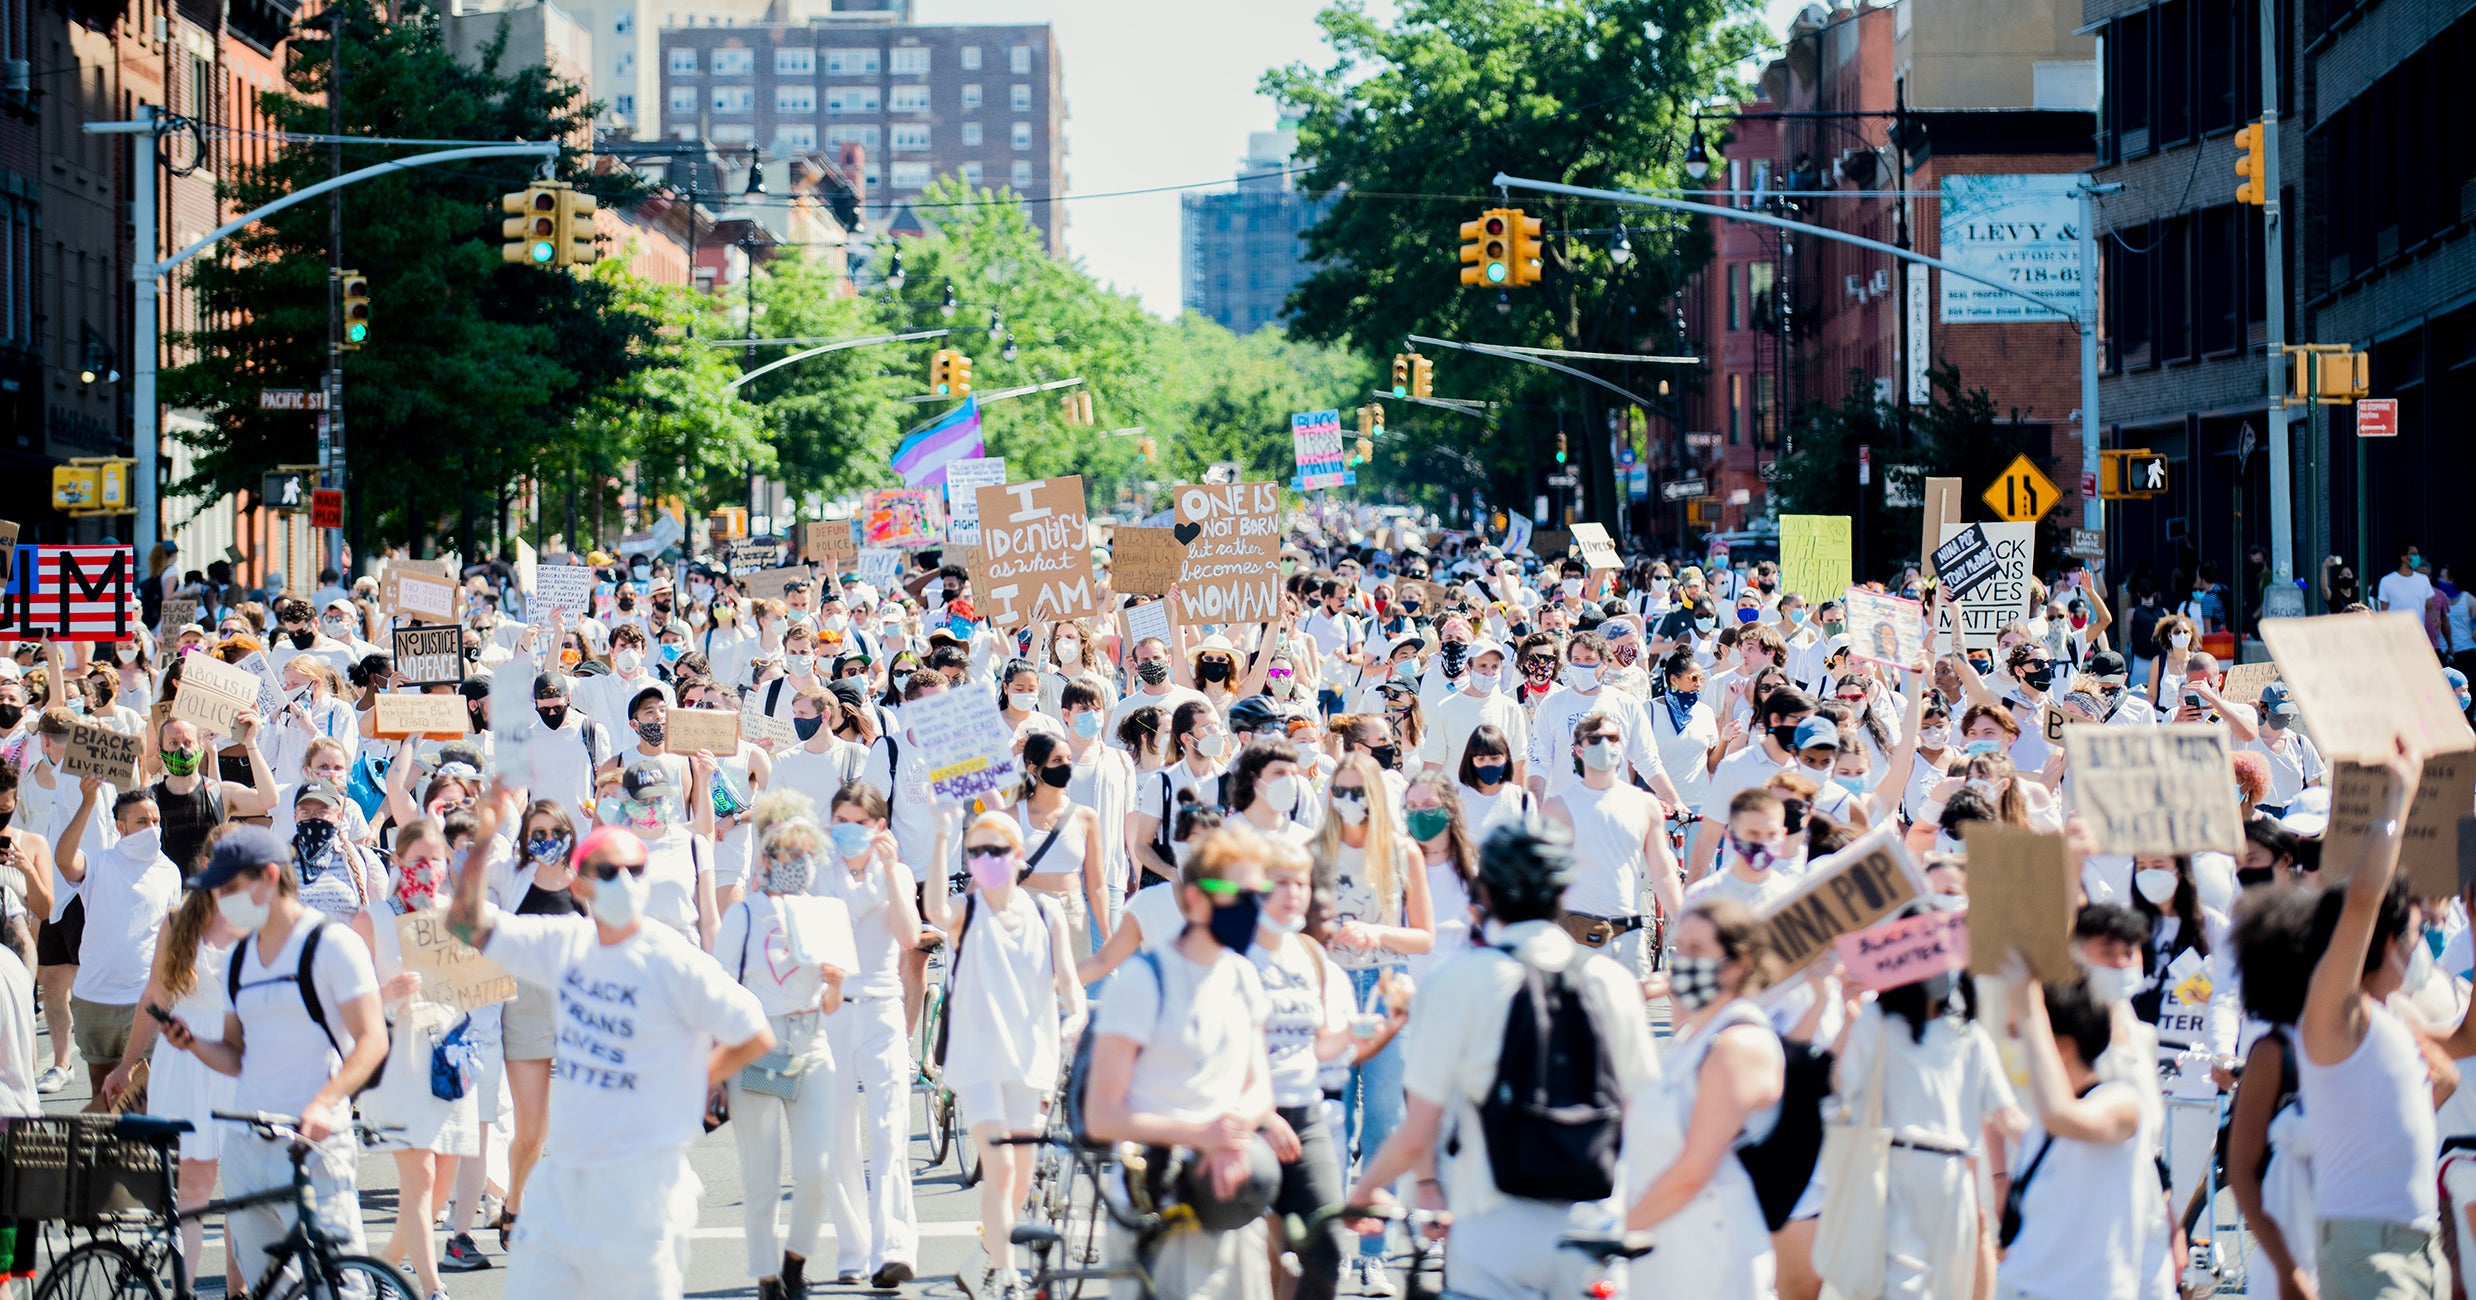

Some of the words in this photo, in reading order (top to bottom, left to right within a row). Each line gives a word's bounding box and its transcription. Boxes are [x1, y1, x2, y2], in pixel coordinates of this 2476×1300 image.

[1968, 222, 2047, 241] LEVY
[1996, 251, 2080, 261] ATTORNE
[261, 392, 303, 409] PACIFIC
[308, 392, 322, 409] ST
[1005, 480, 1051, 523] I
[1181, 484, 1249, 522] ONE
[1254, 482, 1277, 514] IS
[953, 519, 978, 530] FIGHT
[1202, 517, 1235, 538] NOT
[1240, 513, 1279, 537] BORN
[1782, 518, 1811, 535] DO
[2076, 531, 2099, 540] FUCK
[816, 538, 850, 551] POLICE
[1187, 539, 1213, 559] but
[1215, 538, 1265, 556] rather
[1781, 535, 1828, 560] THE
[1937, 540, 1961, 564] NINA
[1957, 529, 1975, 549] POP
[990, 562, 1016, 580] as
[1014, 551, 1077, 574] what
[1265, 560, 1280, 570] a
[1782, 559, 1850, 583] RIGHT
[1943, 563, 1969, 588] TONY
[403, 593, 420, 604] NO
[423, 597, 447, 610] PEACE
[404, 582, 419, 593] NO
[422, 584, 453, 600] JUSTICE
[990, 583, 1019, 626] I
[1032, 574, 1093, 615] AM
[1180, 573, 1278, 622] WOMAN
[162, 603, 194, 612] BLACK
[162, 613, 194, 624] TRANS
[413, 630, 457, 656] JUSTICE
[398, 657, 417, 682] NO
[418, 655, 460, 681] PEACE
[184, 665, 252, 700] ABOLISH
[177, 688, 240, 730] POLICE
[952, 725, 970, 736] NOT
[973, 716, 999, 731] EXIST
[68, 756, 104, 774] LIVES
[86, 745, 137, 765] TRANS
[933, 774, 969, 796] BLACK
[971, 760, 1015, 780] TRANS
[951, 779, 998, 800] WOMEN
[1829, 851, 1898, 923] POP
[565, 966, 638, 1007] BLACK
